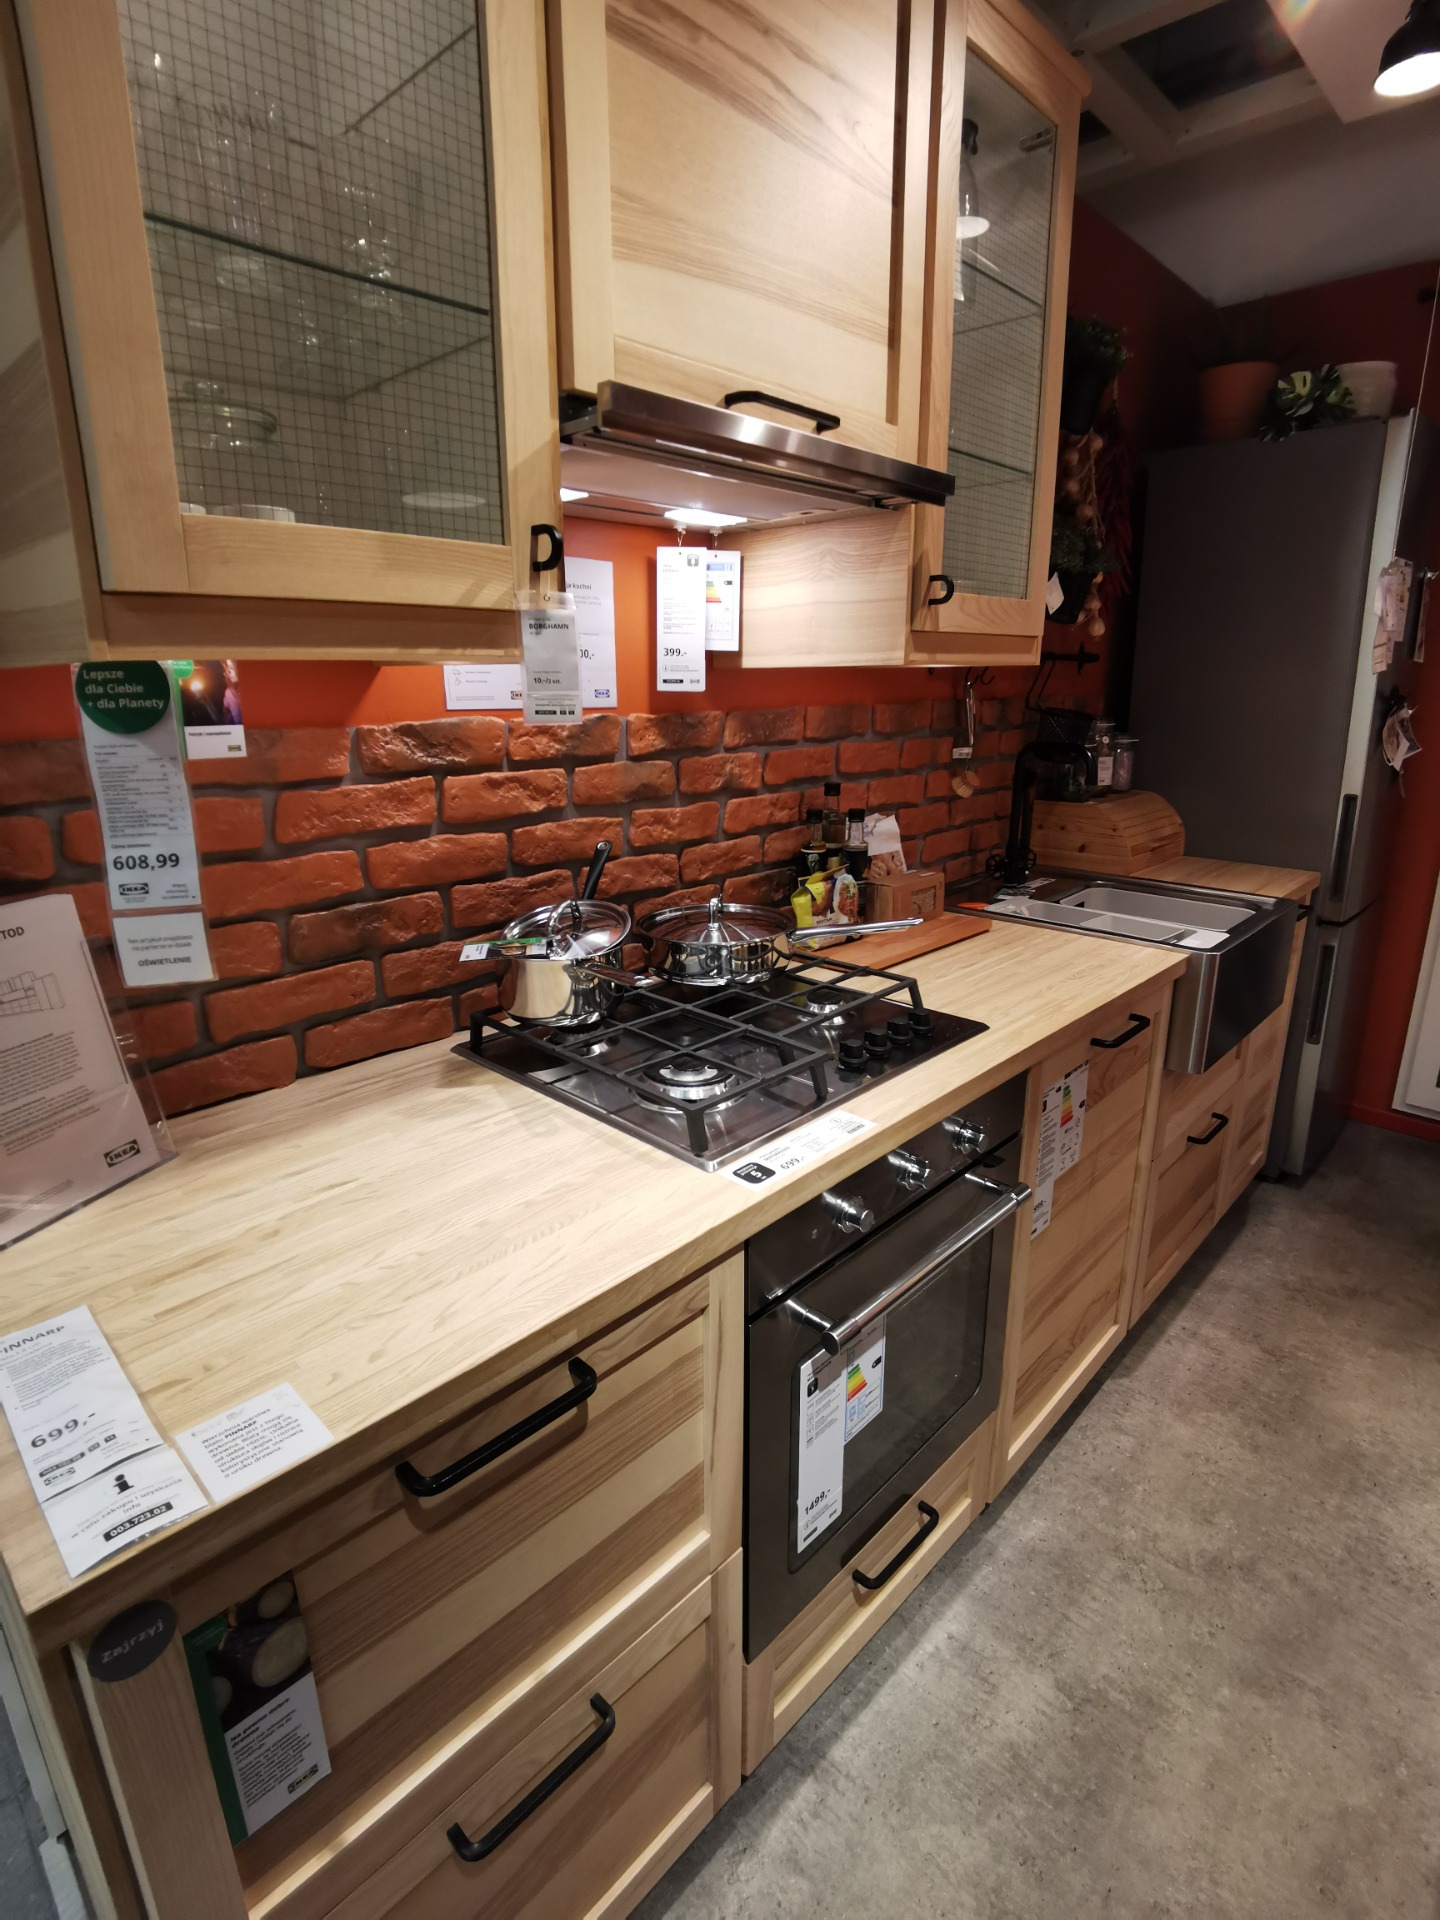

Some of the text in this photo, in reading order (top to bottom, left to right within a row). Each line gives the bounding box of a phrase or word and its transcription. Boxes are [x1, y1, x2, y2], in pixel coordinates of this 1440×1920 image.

[83, 670, 124, 680] Lepsze
[85, 683, 144, 694] dla Ciebie
[97, 699, 116, 708] dla
[119, 698, 164, 709] Planety
[113, 853, 180, 870] 608,99
[138, 956, 192, 966] OŚWIETLENIE
[0, 1326, 64, 1353] INNARP
[31, 1412, 96, 1448] 699,-
[201, 1424, 241, 1444] Wierzchnia
[204, 1420, 257, 1449] blatu PINNARP
[225, 1446, 245, 1457] siebie
[102, 1499, 134, 1518] zakupu
[140, 1478, 182, 1498] uzyskania
[124, 1503, 141, 1514] info
[110, 1505, 167, 1537] 003.723.02
